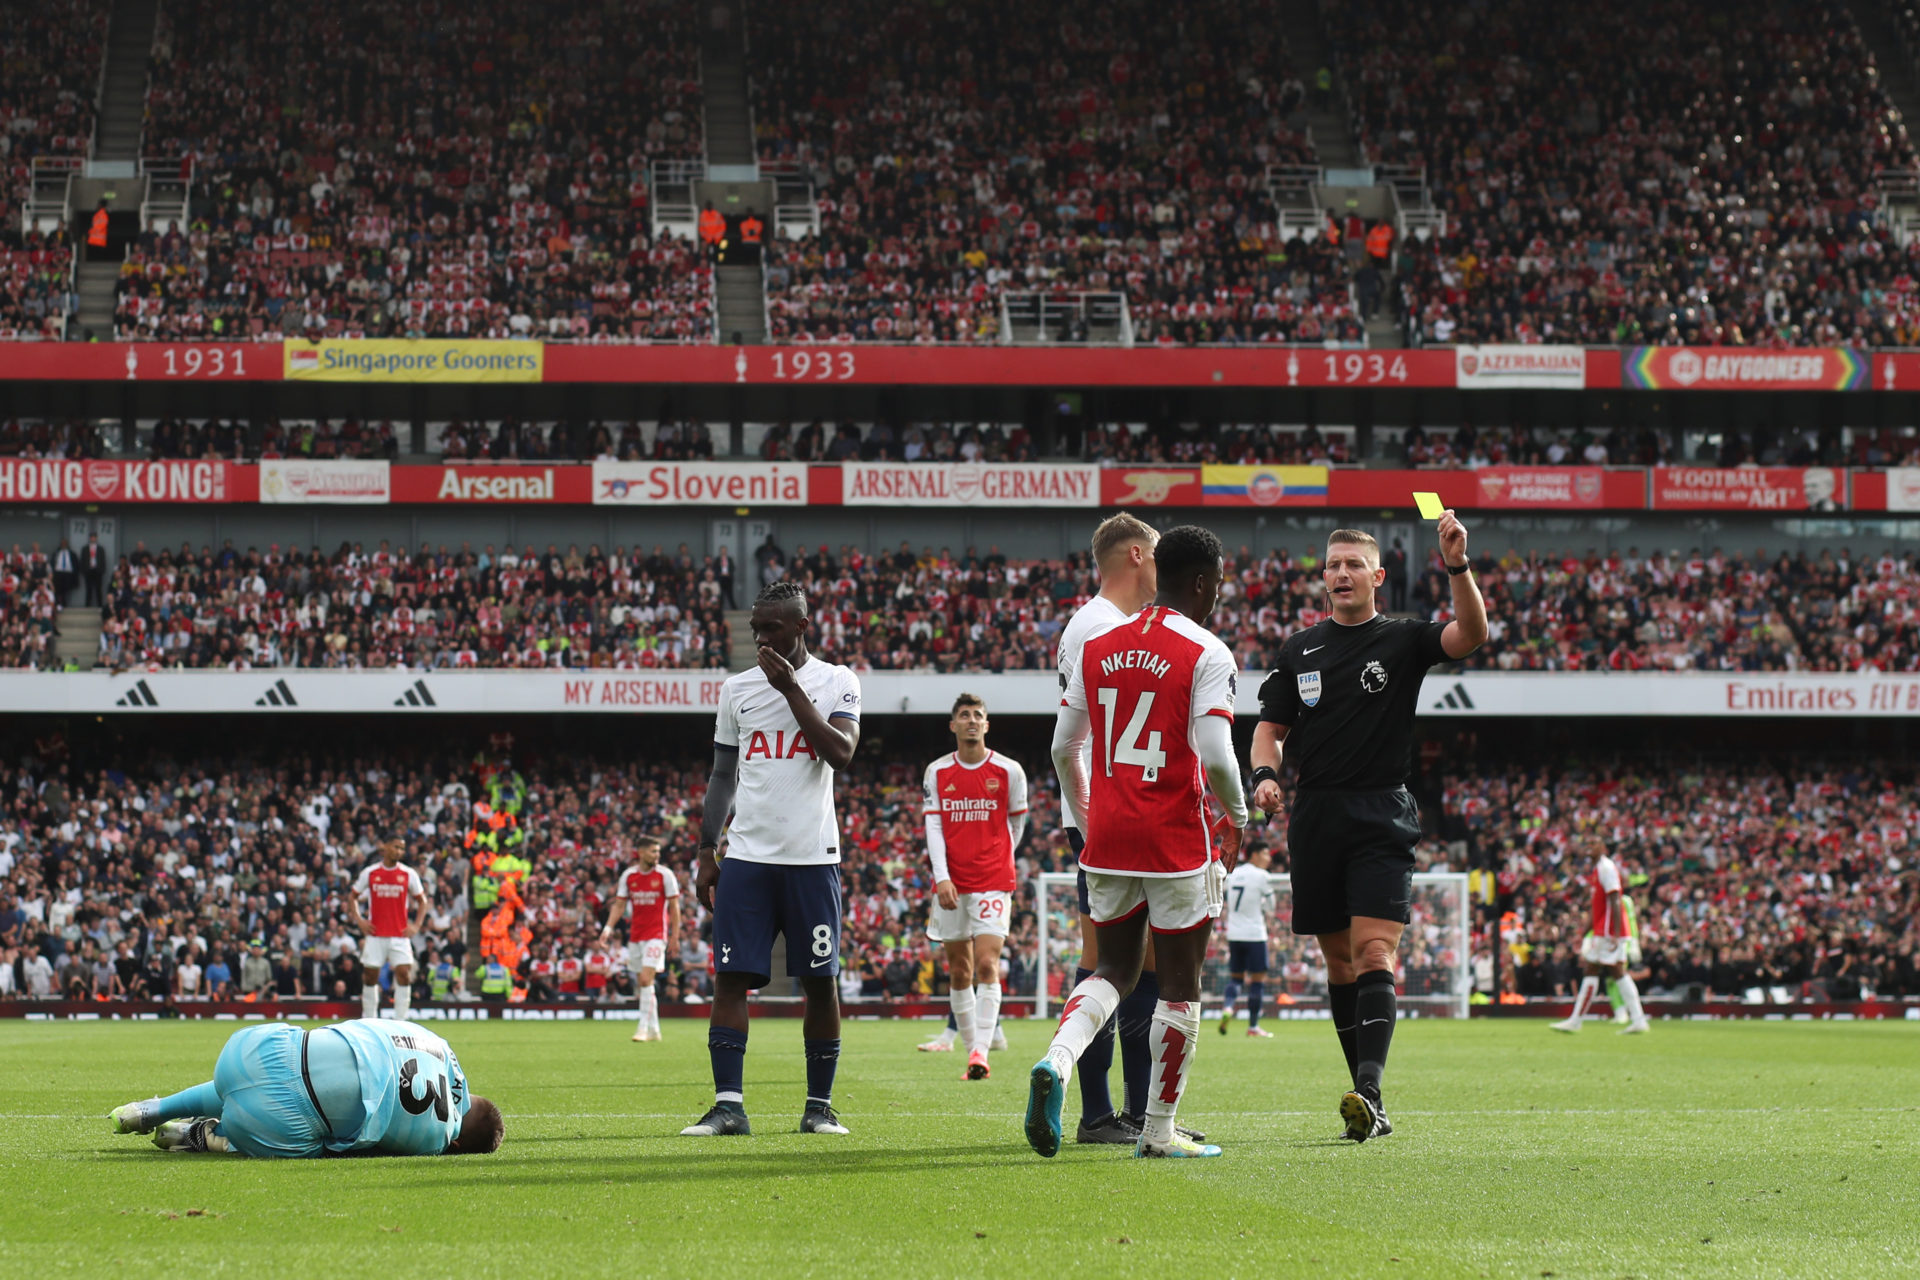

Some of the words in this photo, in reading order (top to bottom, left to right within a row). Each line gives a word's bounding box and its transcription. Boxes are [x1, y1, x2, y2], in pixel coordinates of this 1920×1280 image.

[163, 348, 246, 376] 1931
[324, 348, 436, 373] Singapore
[444, 349, 537, 370] Gooners
[771, 351, 855, 379] 1933
[1324, 354, 1408, 382] 1934
[1704, 355, 1825, 380] GAYGOONERS
[0, 461, 83, 499] HONG
[125, 462, 212, 499] KONG
[438, 469, 554, 499] Arsenal
[649, 467, 800, 500] Slovenia
[852, 469, 949, 498] ARSENAL
[982, 469, 1092, 499] GERMANY
[1100, 650, 1171, 679] NKETIAH
[1299, 673, 1318, 684] FIFA
[565, 681, 595, 705] MY
[601, 681, 692, 705] ARSENAL
[1727, 682, 1857, 710] Emirates
[1869, 683, 1903, 710] FLY
[745, 730, 818, 761] AIA
[1098, 688, 1166, 782] 14
[942, 797, 998, 811] Emirates
[951, 811, 964, 822] FLY
[965, 811, 990, 821] BETTER
[978, 899, 1004, 919] 29
[1232, 886, 1245, 912] 7
[812, 924, 832, 957] 8
